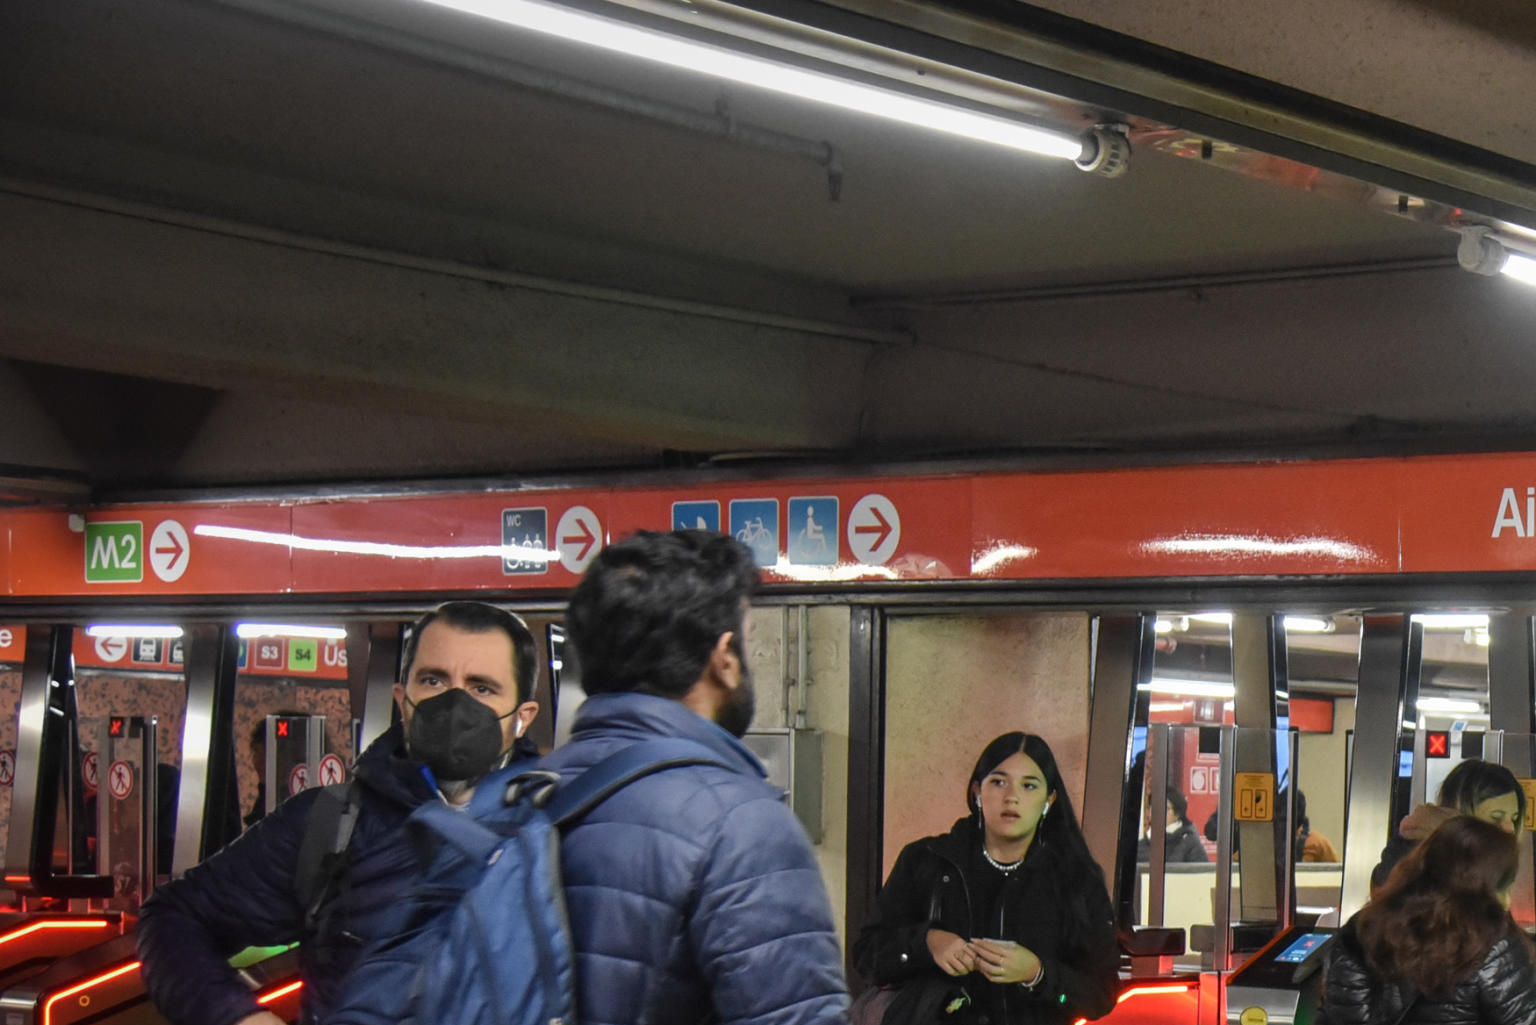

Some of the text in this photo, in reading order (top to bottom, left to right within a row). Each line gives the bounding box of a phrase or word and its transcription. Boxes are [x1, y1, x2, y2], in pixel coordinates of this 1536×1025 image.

[506, 514, 522, 528] WC
[1491, 486, 1536, 538] Ai
[90, 534, 137, 570] M2
[260, 645, 279, 660] S3
[294, 648, 311, 662] S4
